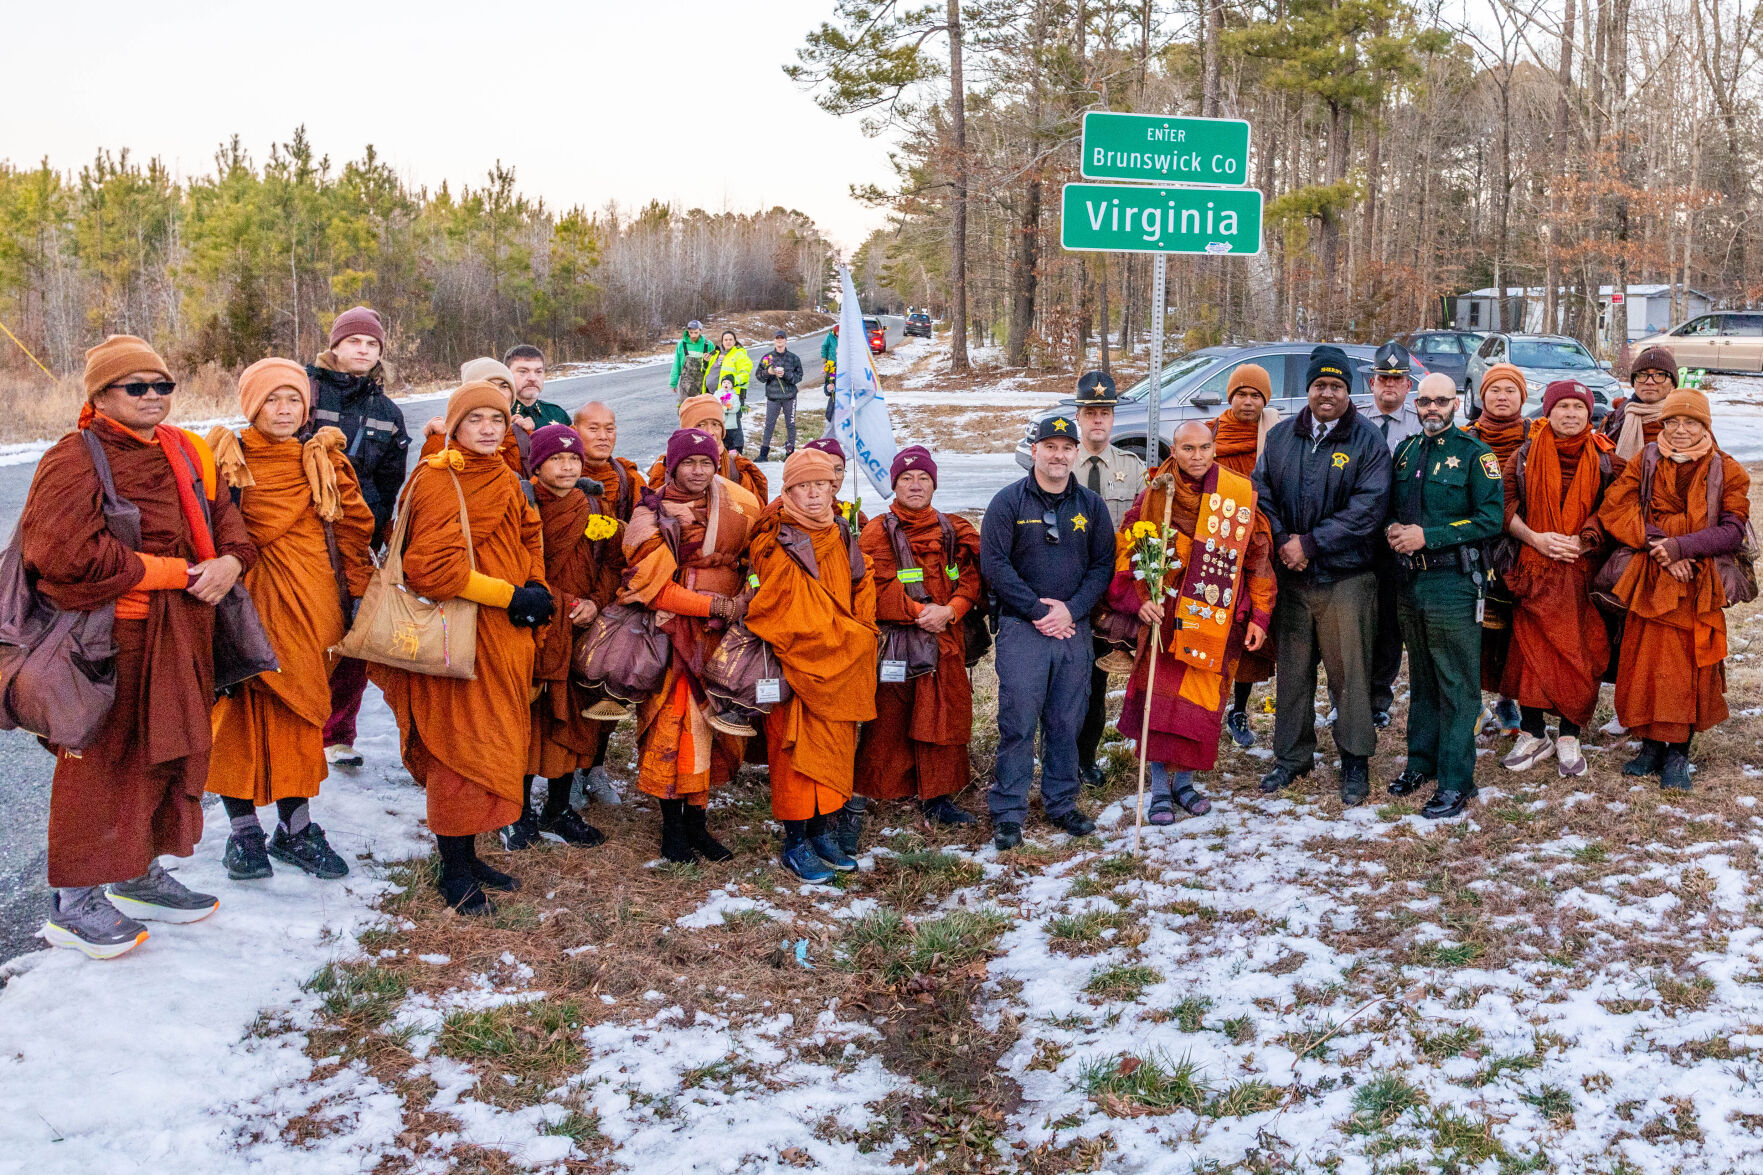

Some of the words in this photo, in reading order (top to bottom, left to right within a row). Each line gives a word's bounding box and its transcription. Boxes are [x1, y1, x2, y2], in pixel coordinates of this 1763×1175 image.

[1147, 127, 1186, 142] ENTER
[1093, 147, 1201, 172] Brunswick
[1211, 154, 1237, 174] Co
[1085, 198, 1239, 242] Virginia
[849, 430, 888, 482] PEACE
